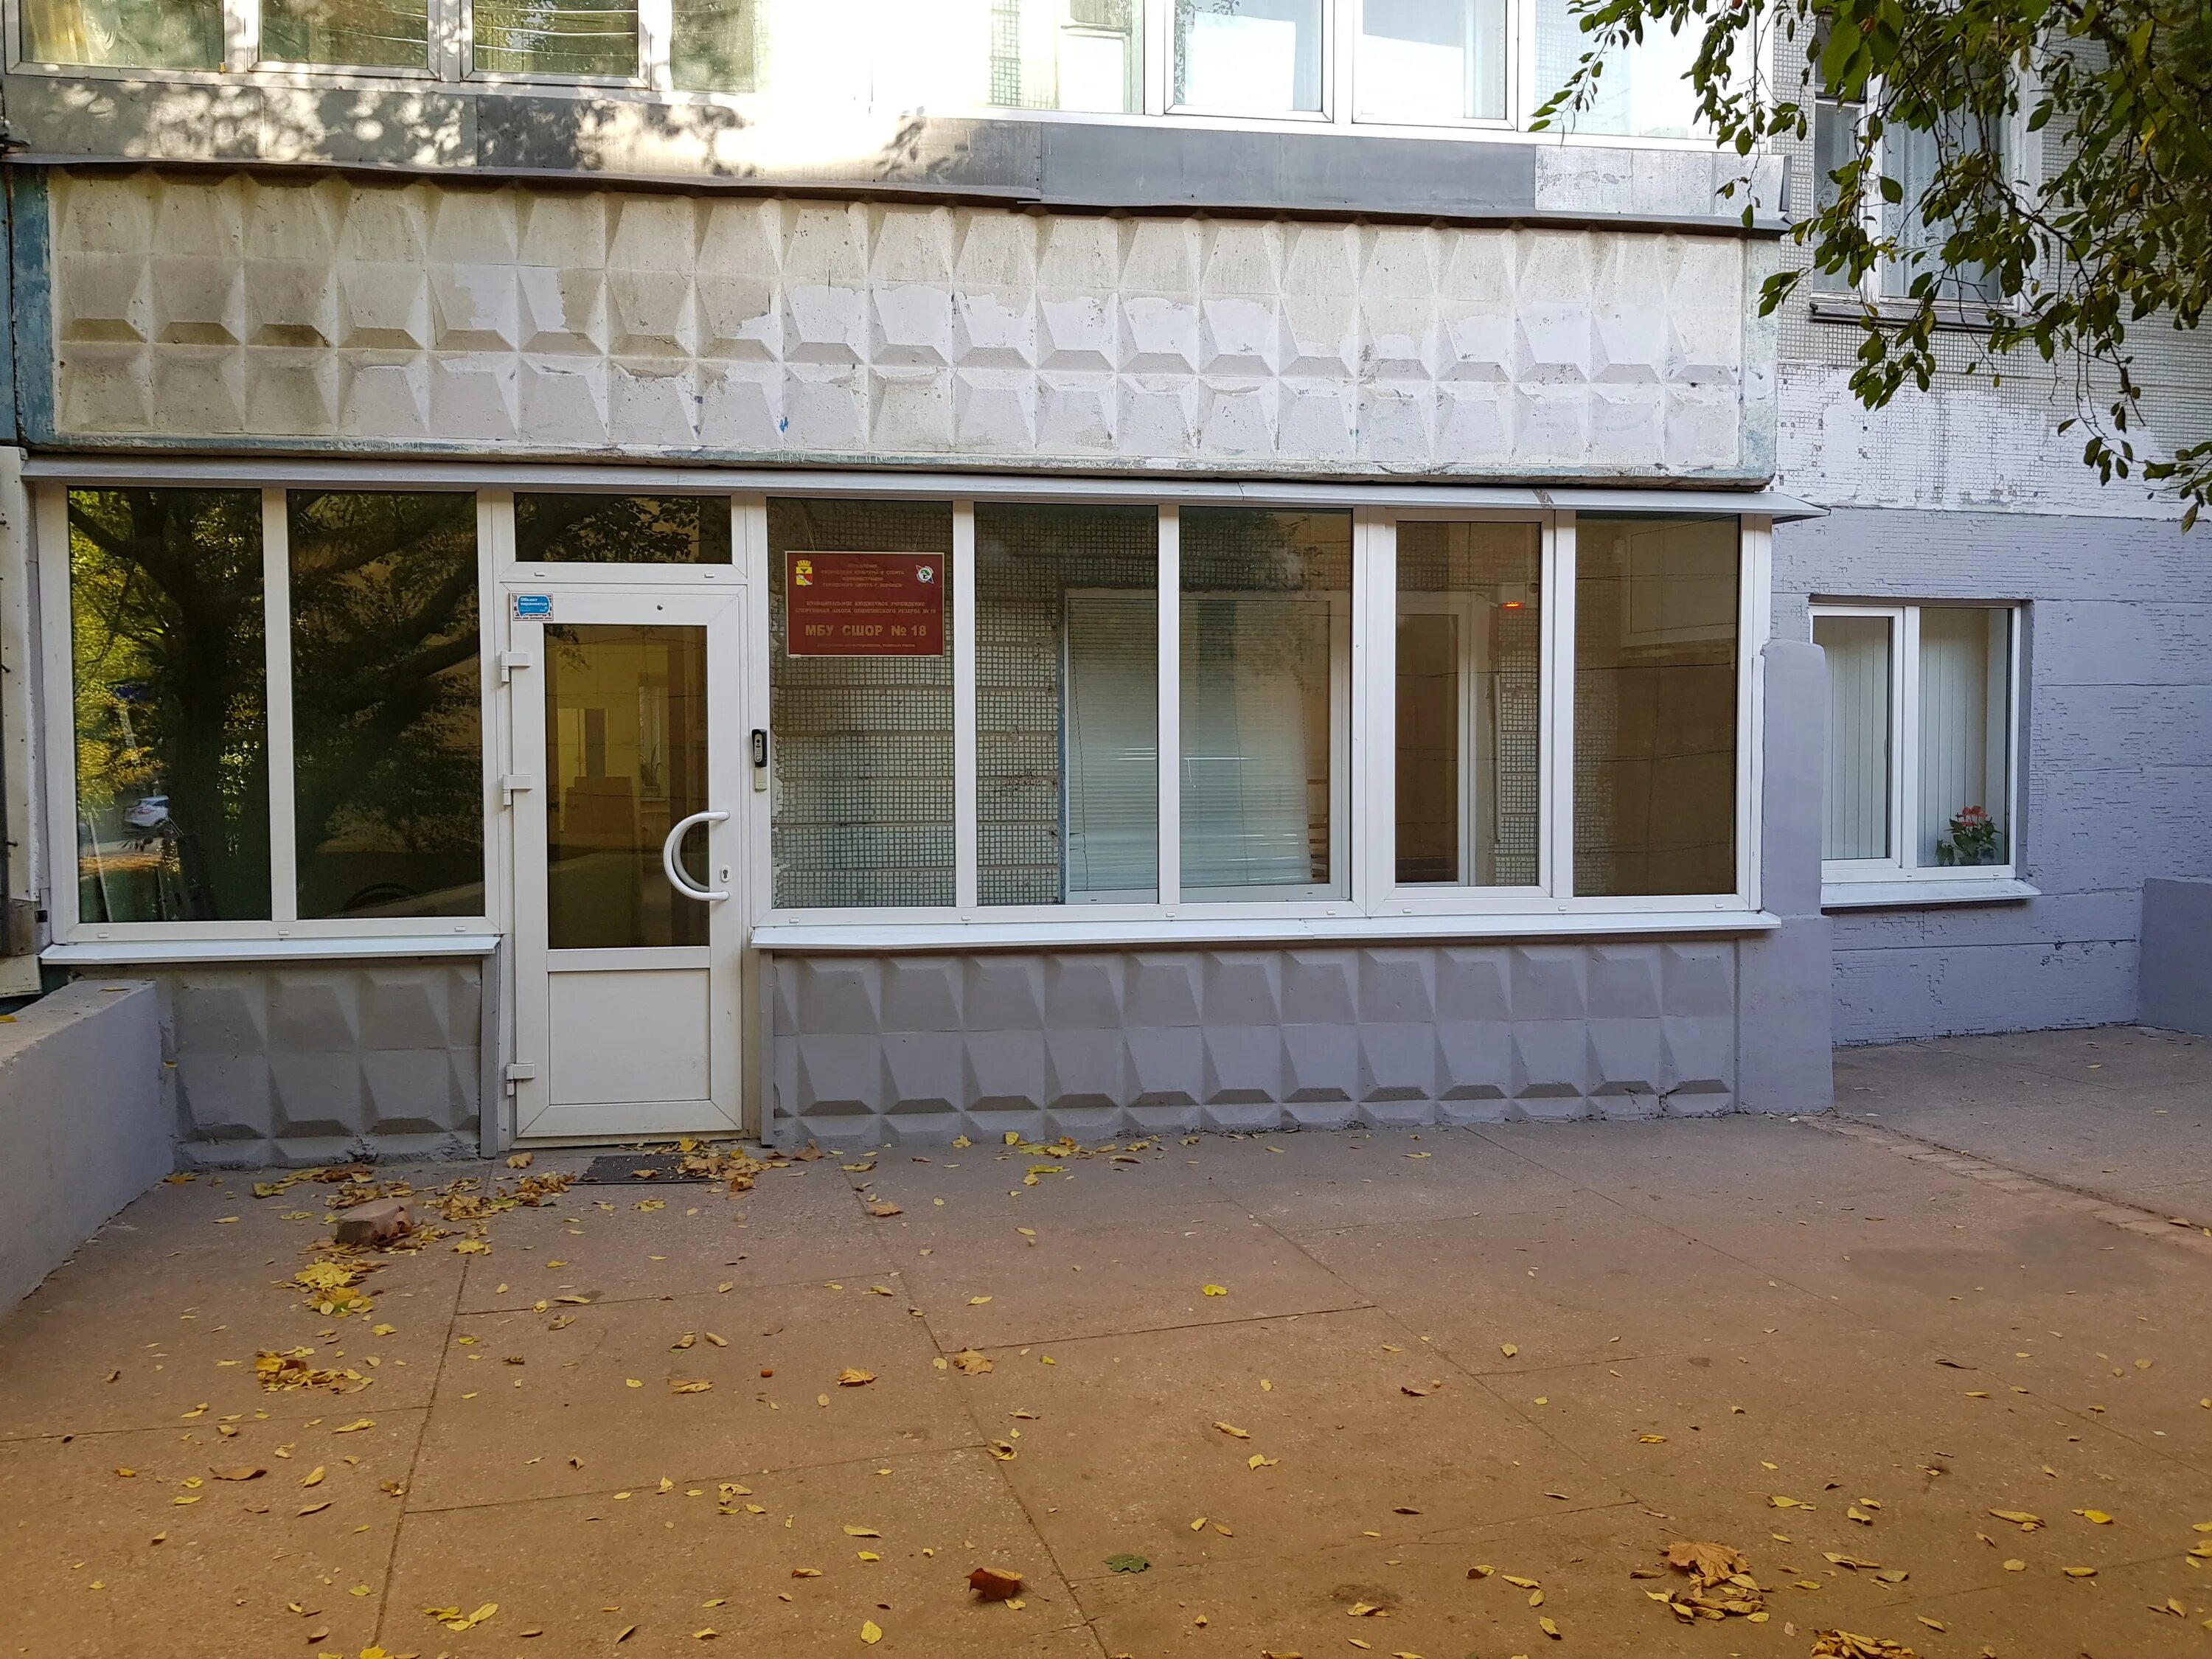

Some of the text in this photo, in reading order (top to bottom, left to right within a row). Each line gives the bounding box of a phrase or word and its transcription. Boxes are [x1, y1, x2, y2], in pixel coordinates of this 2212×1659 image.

[805, 625, 927, 636] МБУ СШОР № 18
